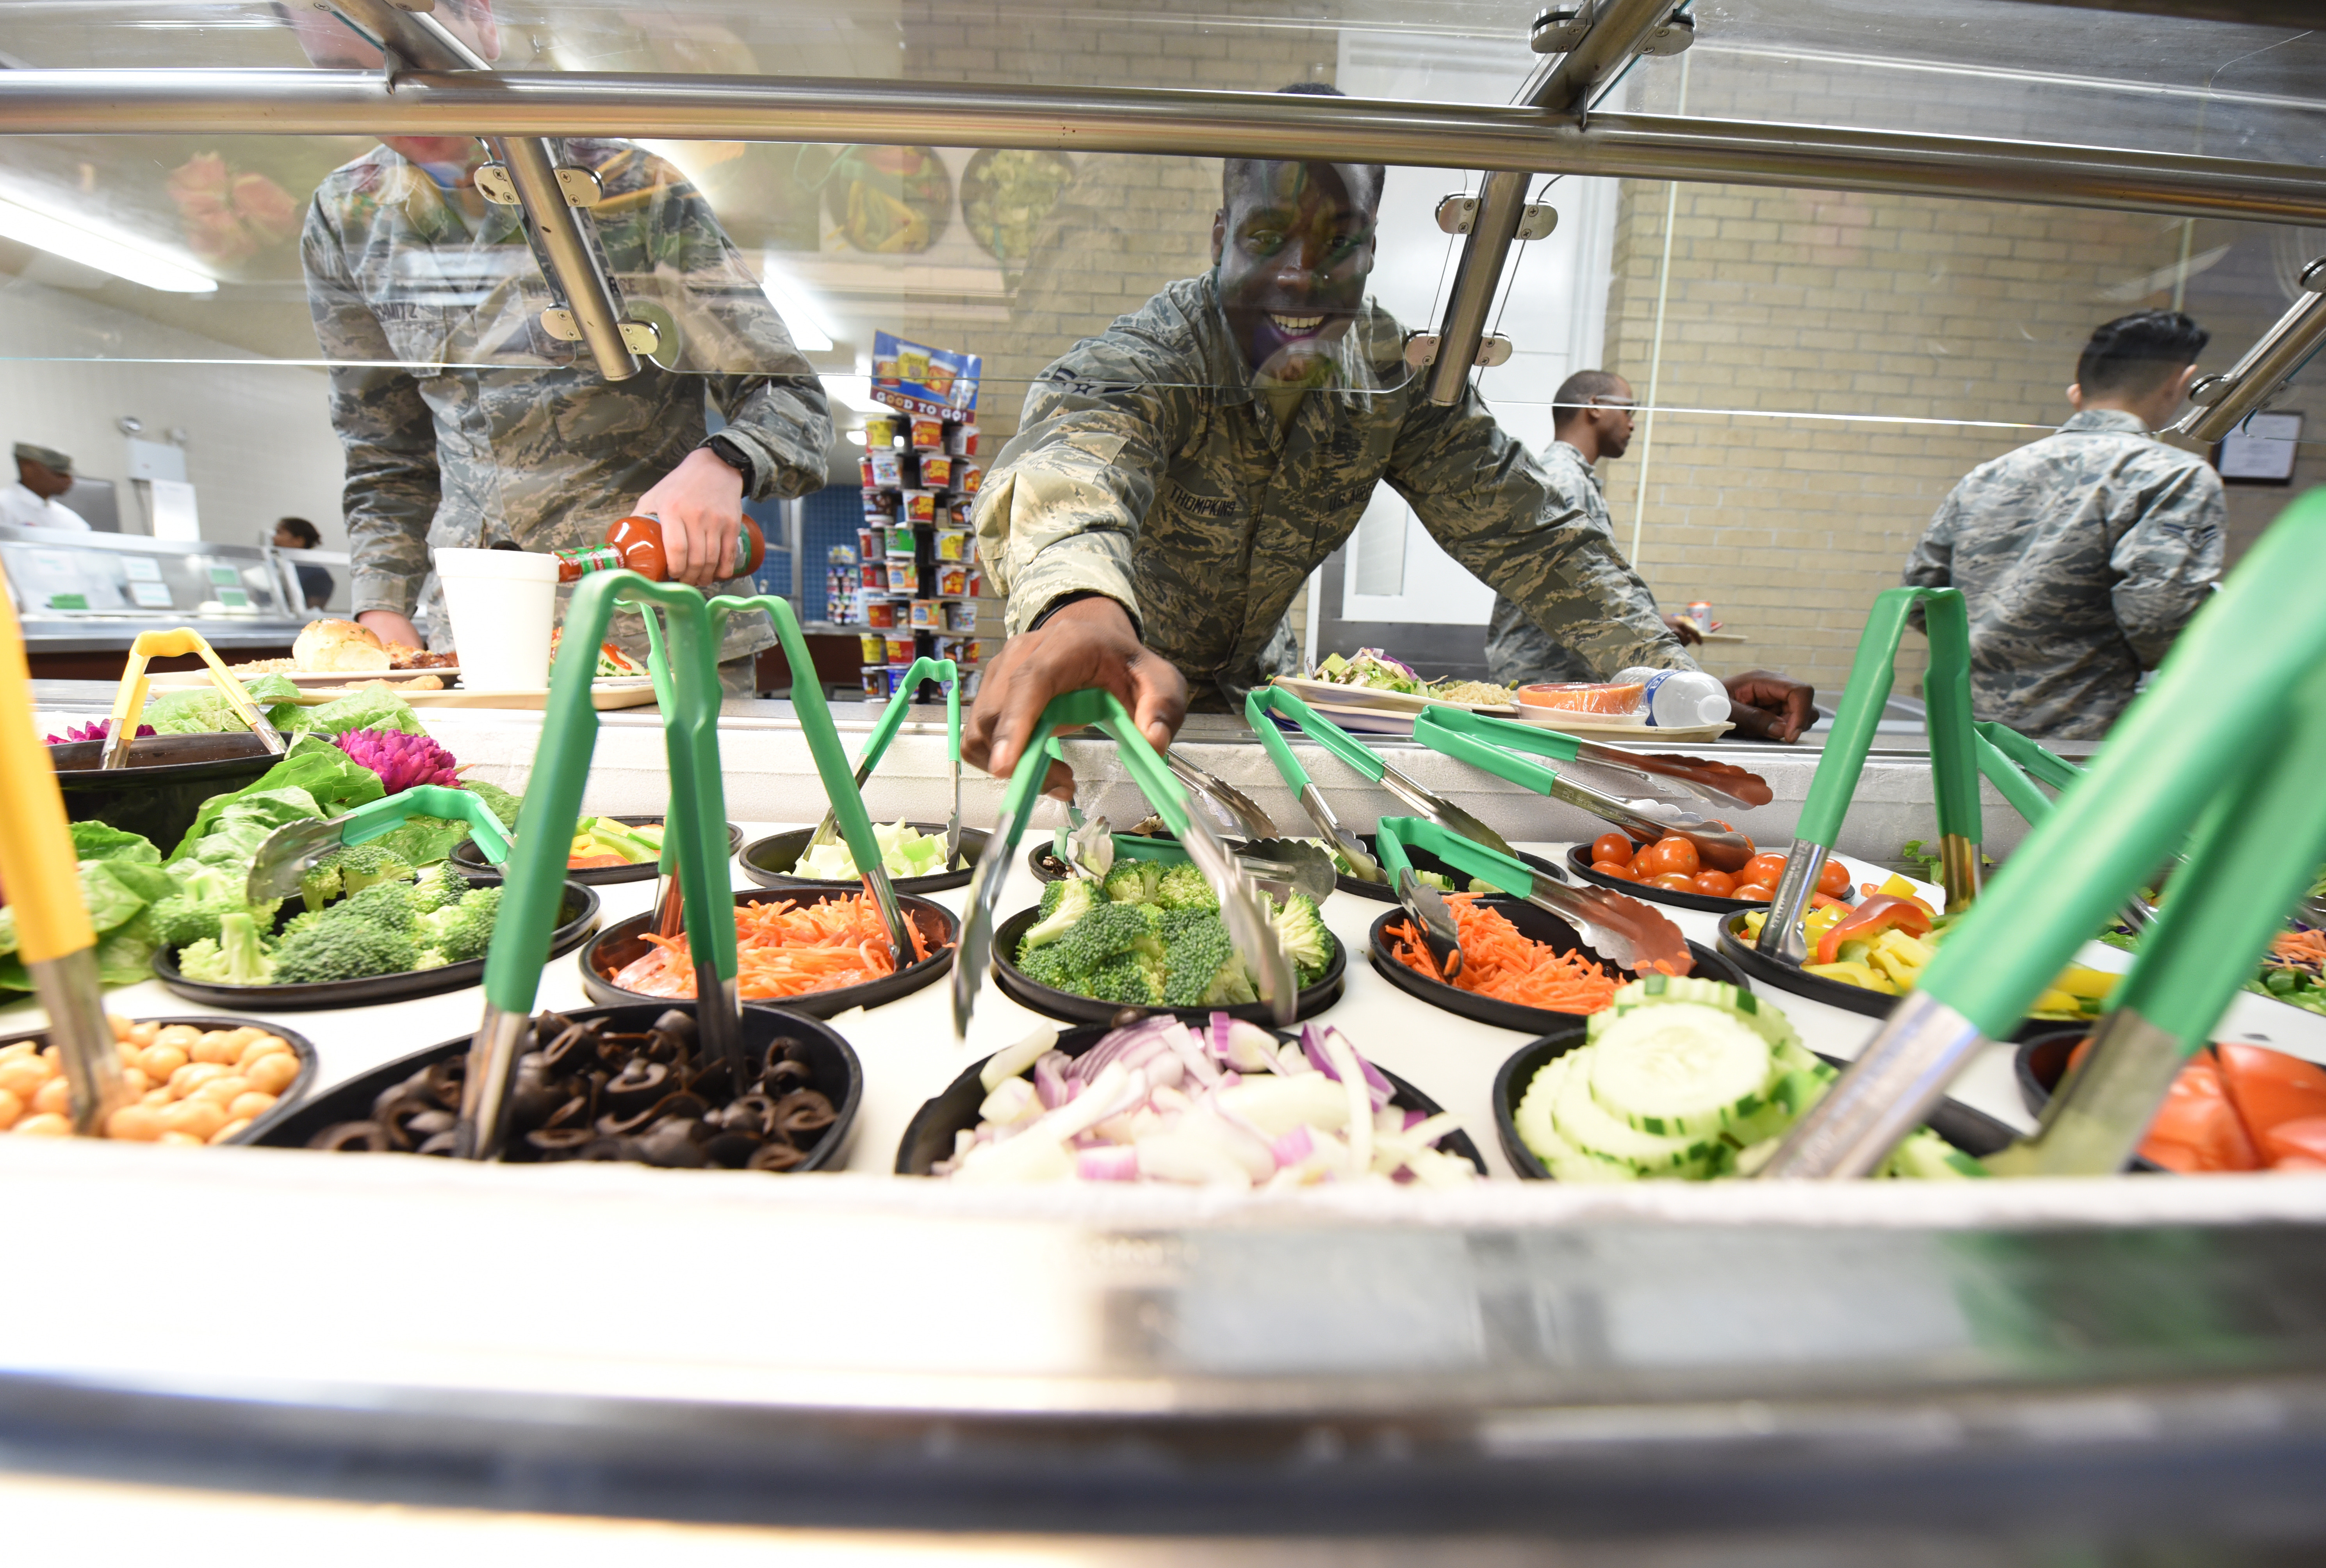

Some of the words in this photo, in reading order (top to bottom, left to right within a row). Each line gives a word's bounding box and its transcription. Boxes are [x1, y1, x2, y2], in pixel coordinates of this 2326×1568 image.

[876, 391, 914, 410] GOOD
[918, 403, 937, 415] TO
[941, 408, 967, 422] GO!
[1170, 484, 1236, 517] THOMPKINS
